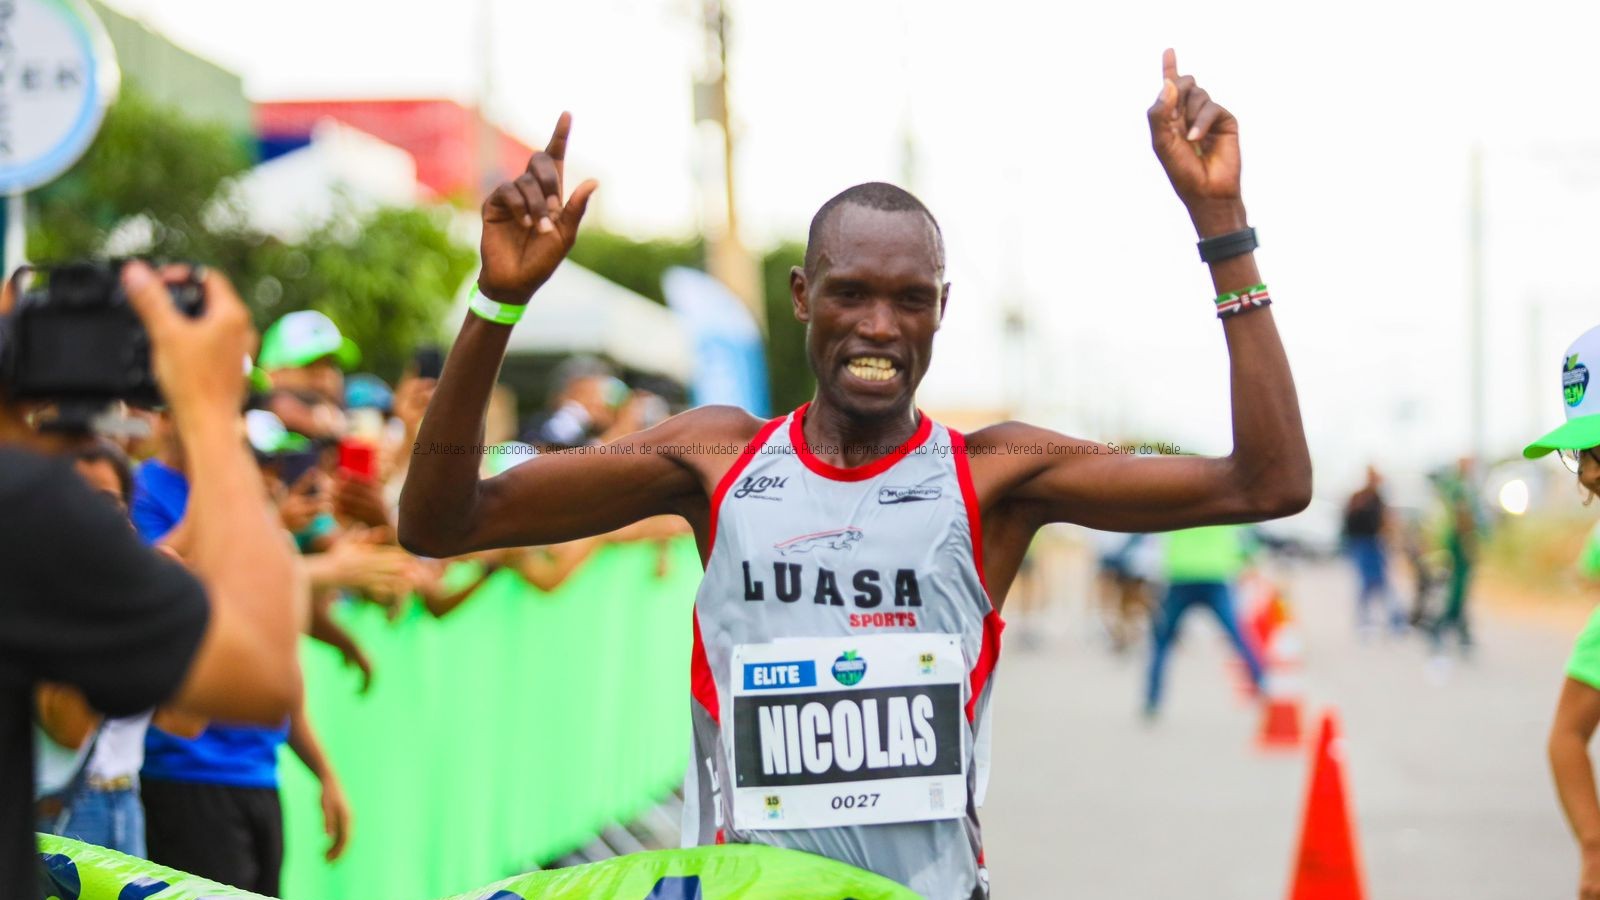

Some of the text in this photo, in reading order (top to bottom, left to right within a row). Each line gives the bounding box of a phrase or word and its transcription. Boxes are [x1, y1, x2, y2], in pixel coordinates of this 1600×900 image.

[742, 560, 922, 608] LUASA
[849, 612, 917, 628] SPORTS
[753, 664, 801, 686] ELITE
[758, 694, 937, 775] NICOLAS
[831, 793, 881, 810] 0027
